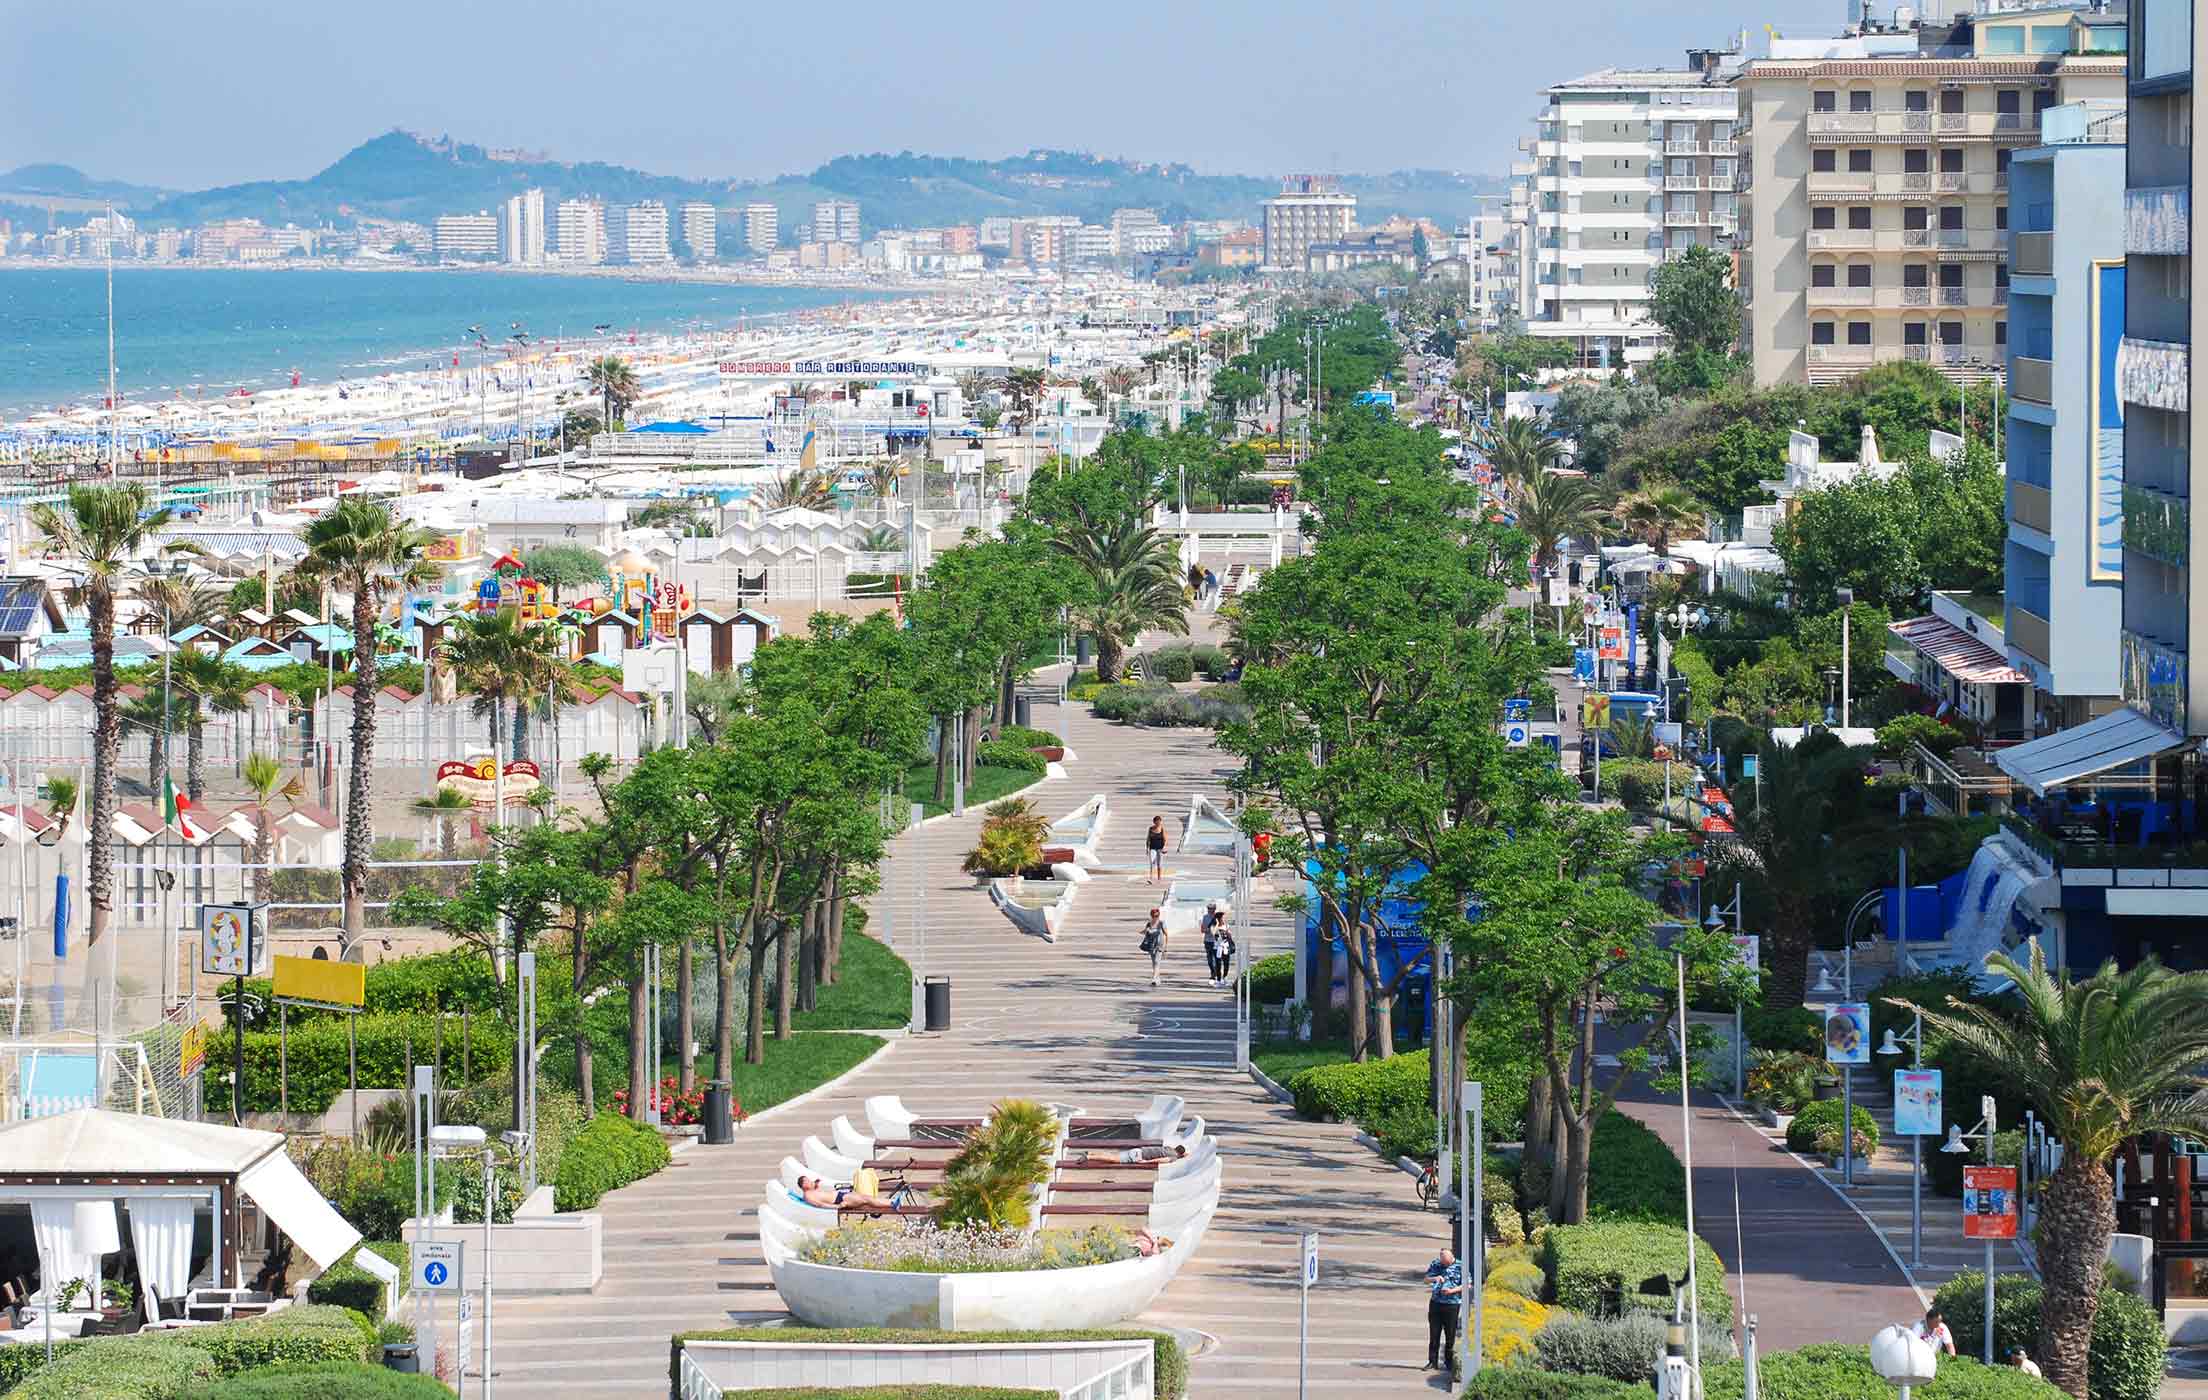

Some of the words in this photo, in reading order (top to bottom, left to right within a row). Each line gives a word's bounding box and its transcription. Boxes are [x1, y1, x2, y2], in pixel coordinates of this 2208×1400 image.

[720, 362, 790, 373] SOMBRERO
[796, 362, 821, 373] BAR
[827, 362, 915, 373] RISTORANTE
